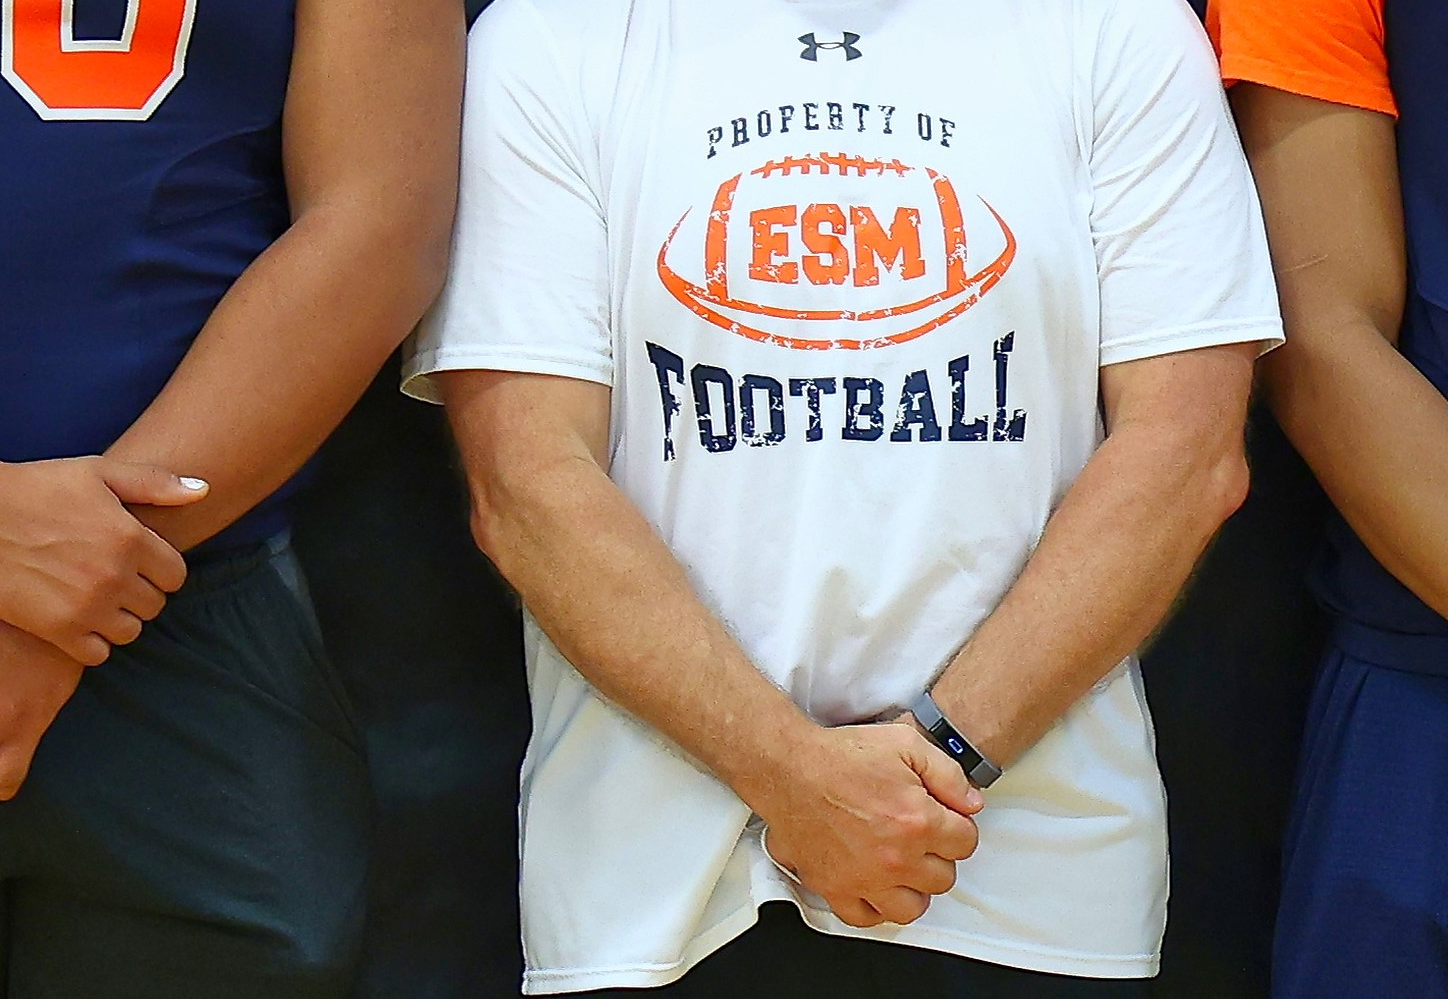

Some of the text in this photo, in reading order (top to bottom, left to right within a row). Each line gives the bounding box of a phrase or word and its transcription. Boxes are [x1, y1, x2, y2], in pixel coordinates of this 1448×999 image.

[706, 102, 957, 159] PROPERTY OF
[748, 203, 926, 288] ESM
[644, 330, 1027, 462] FOOTBALL
